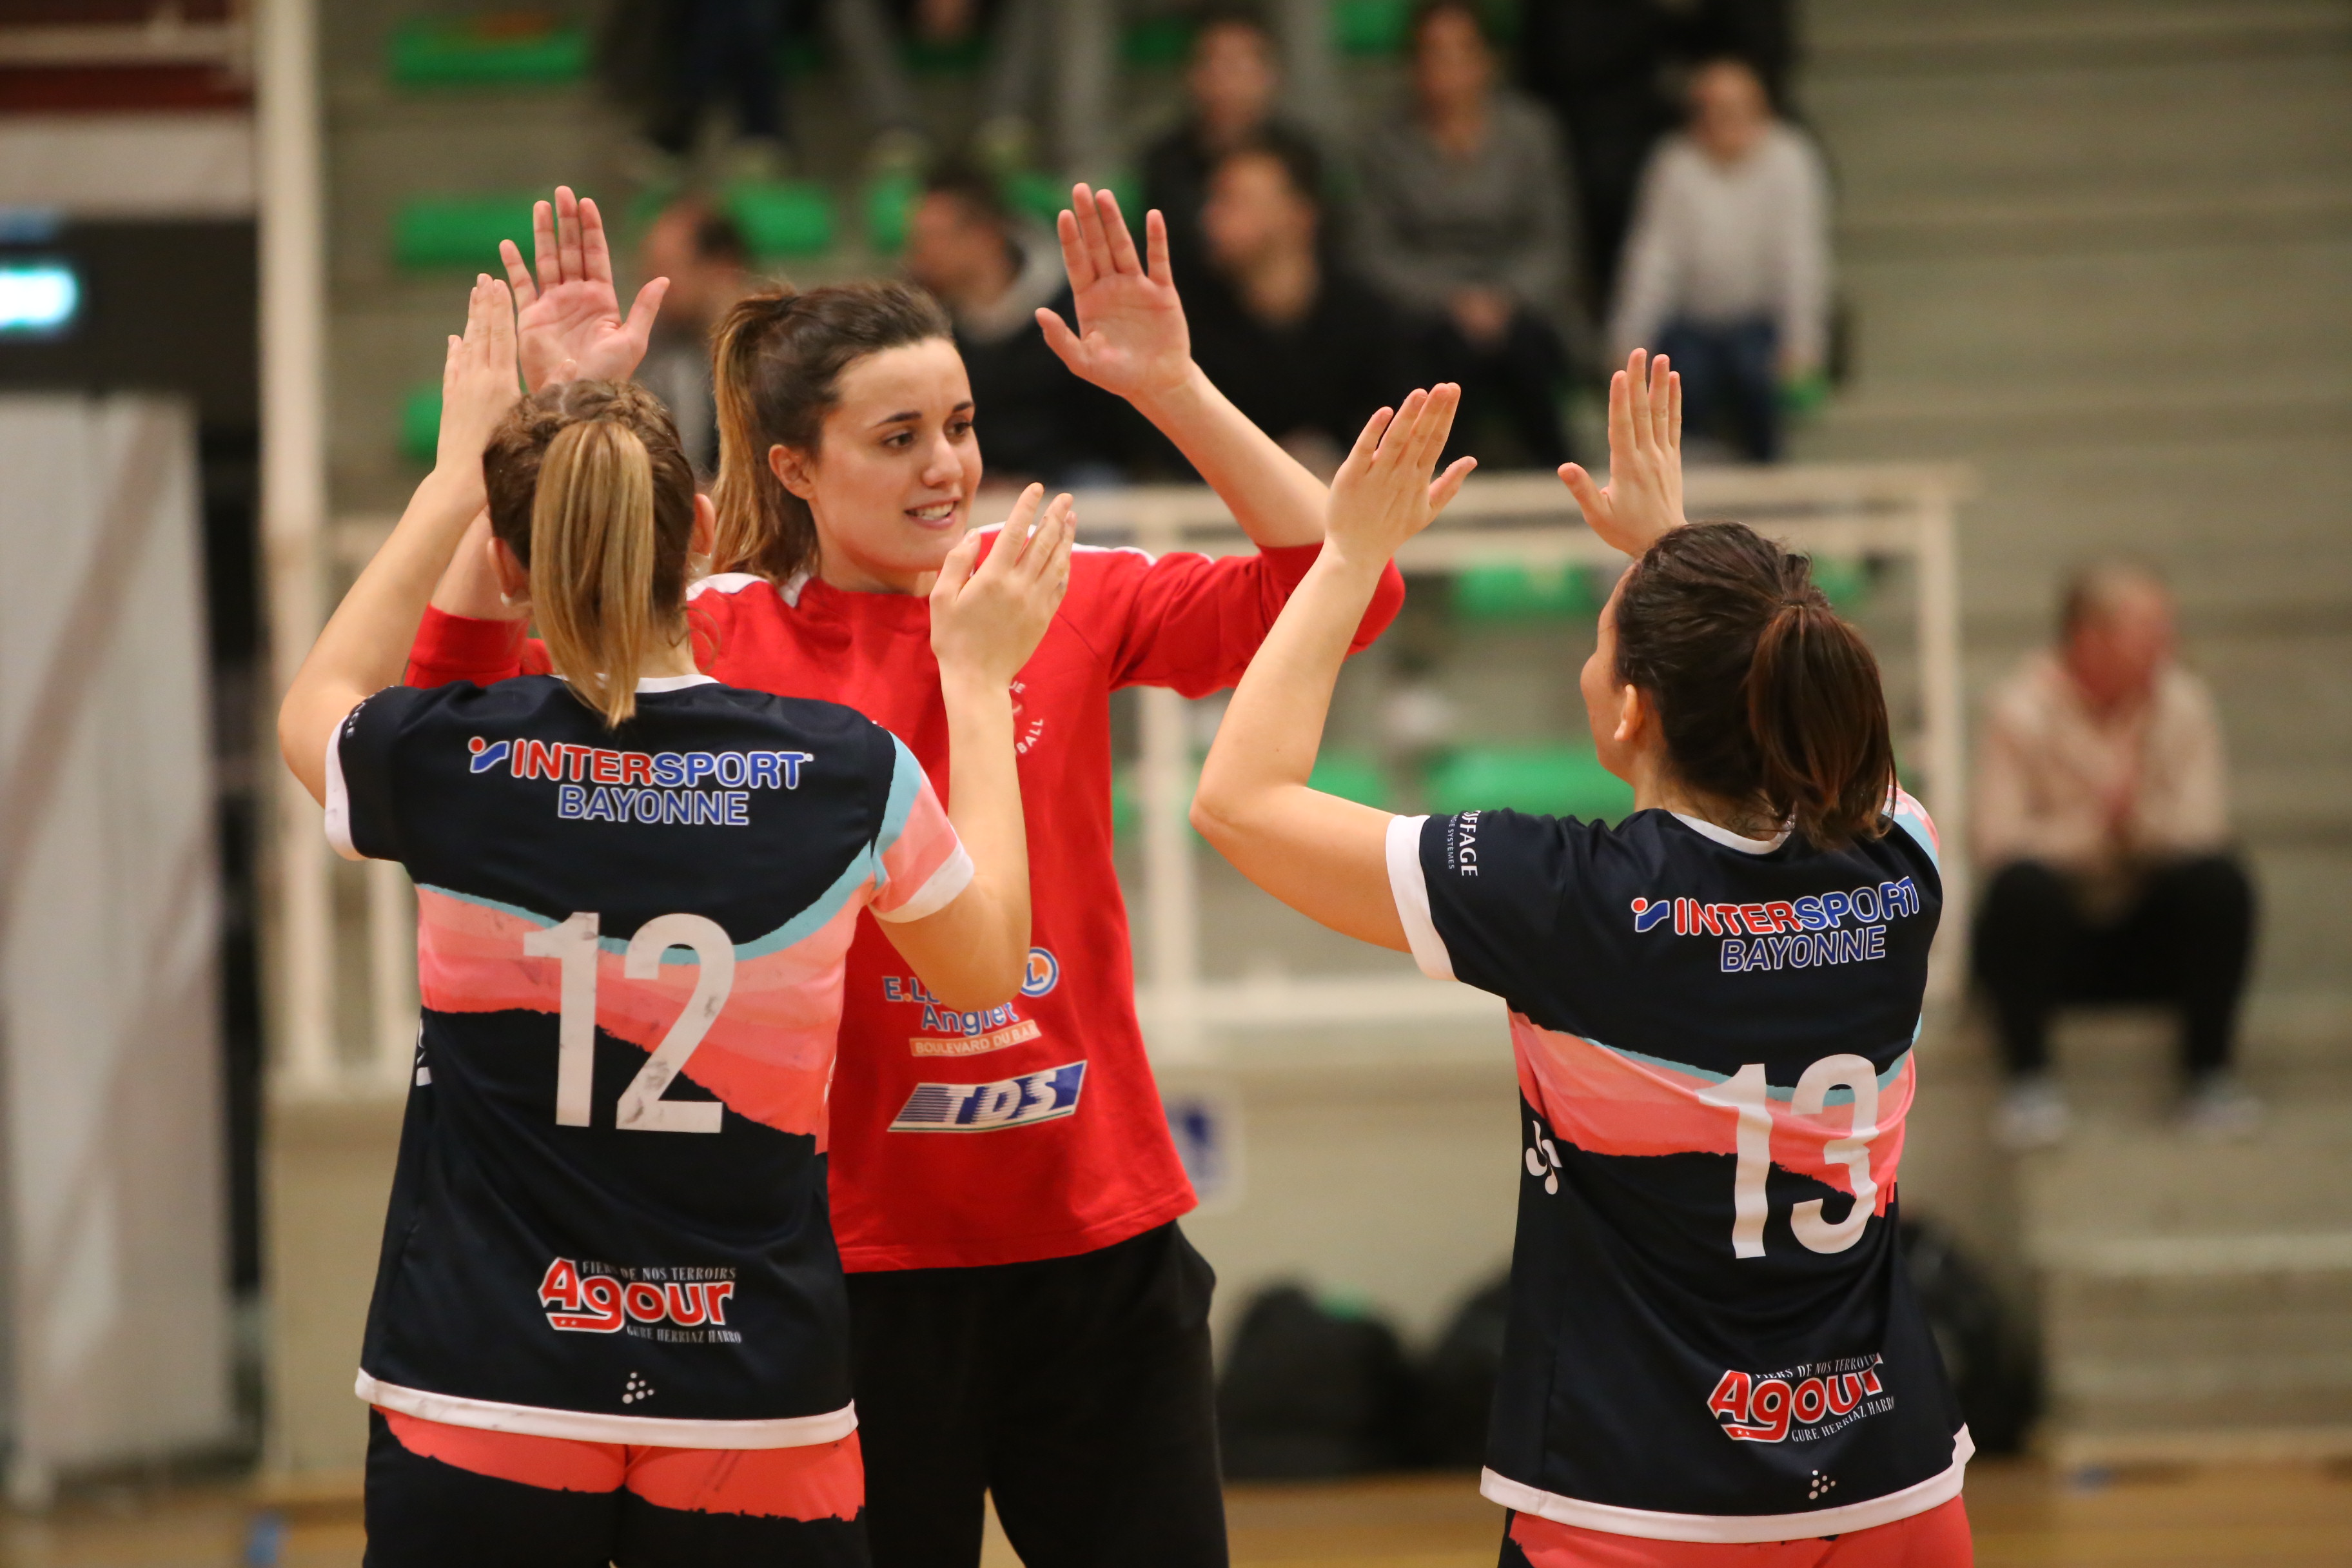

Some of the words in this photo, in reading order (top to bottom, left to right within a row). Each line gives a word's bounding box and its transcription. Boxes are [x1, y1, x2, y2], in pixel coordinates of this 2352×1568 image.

[511, 738, 807, 789] INTERSPORT
[558, 784, 749, 825] BAYONNE
[1675, 876, 1920, 936] INTERSPORT
[1720, 925, 1886, 973] BAYONNE
[524, 912, 736, 1133] 12
[915, 1038, 990, 1054] BOULEVARD
[993, 1033, 1011, 1047] DU
[1695, 1054, 1880, 1259] 13
[538, 1257, 735, 1333] Agour
[642, 1267, 667, 1280] NOS
[671, 1267, 736, 1280] TERROIRS
[1797, 1363, 1812, 1378] DE
[1814, 1361, 1832, 1375] NOS
[1791, 1427, 1819, 1442] GURE
